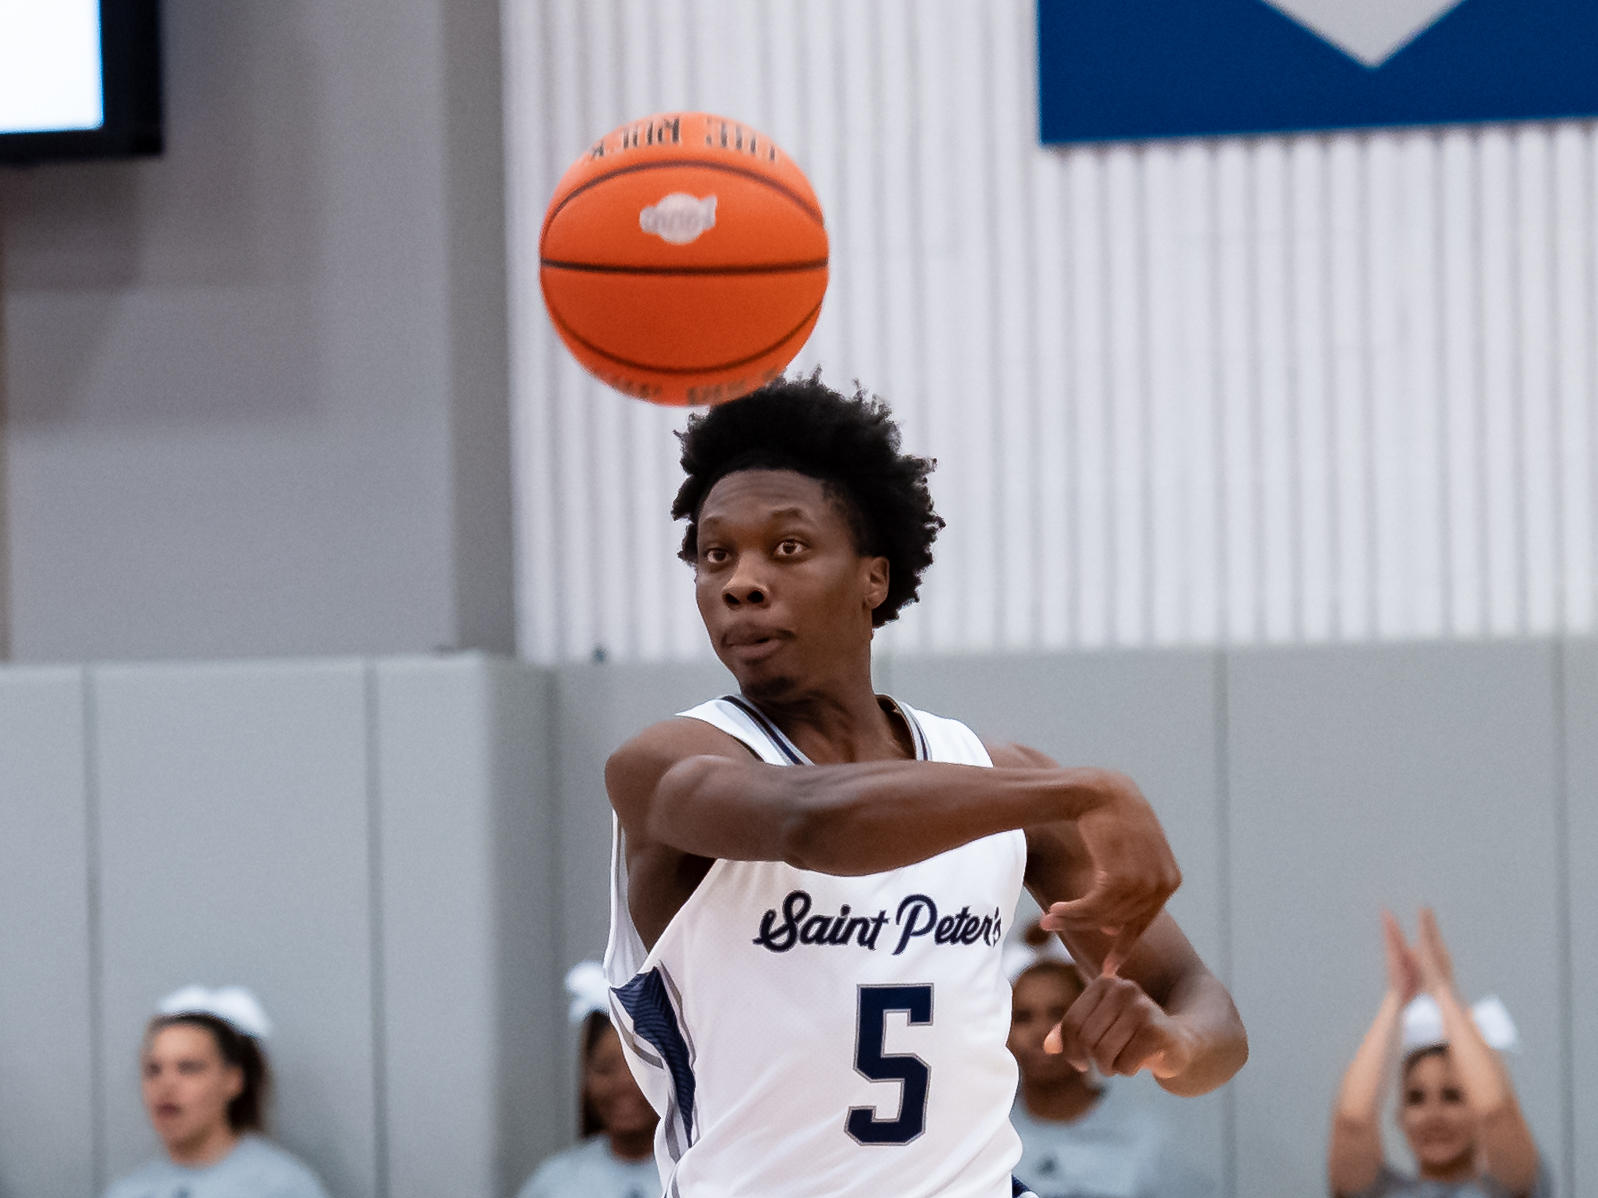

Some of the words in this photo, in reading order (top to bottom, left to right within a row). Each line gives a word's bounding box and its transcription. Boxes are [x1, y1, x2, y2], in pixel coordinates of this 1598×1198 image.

[753, 890, 888, 952] Saint
[891, 893, 1001, 956] Peter's
[843, 982, 935, 1147] 5
